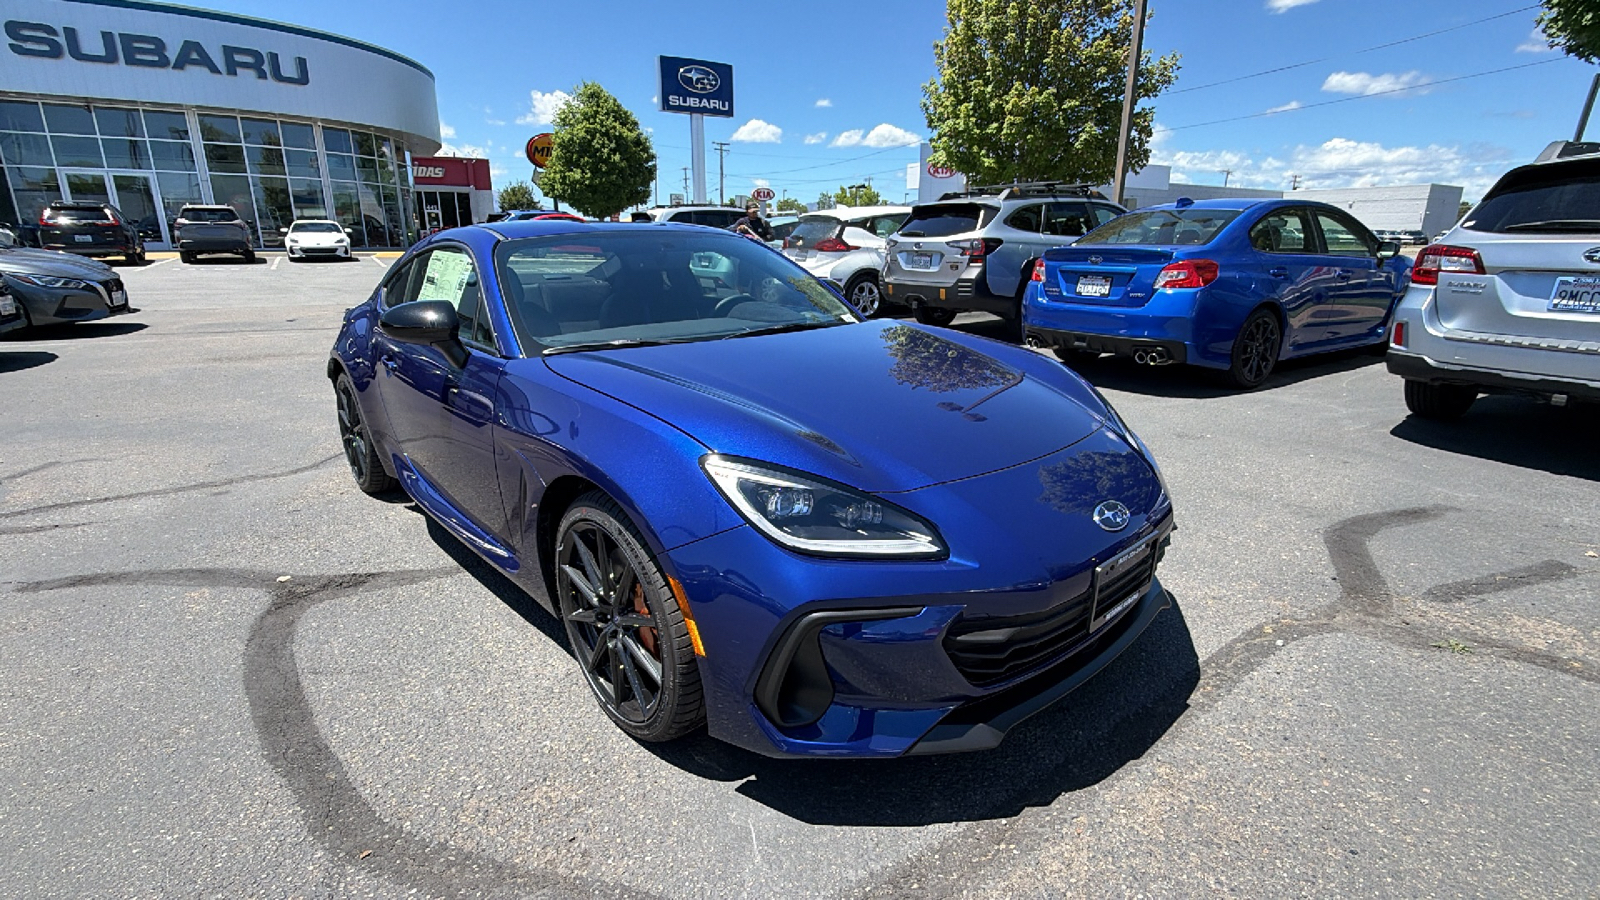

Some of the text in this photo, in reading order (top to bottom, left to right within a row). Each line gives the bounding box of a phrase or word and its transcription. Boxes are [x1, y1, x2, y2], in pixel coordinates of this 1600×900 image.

[4, 20, 310, 86] SUBARU
[668, 95, 729, 111] SUBARU
[412, 163, 445, 178] IDAS
[756, 190, 771, 199] KIA
